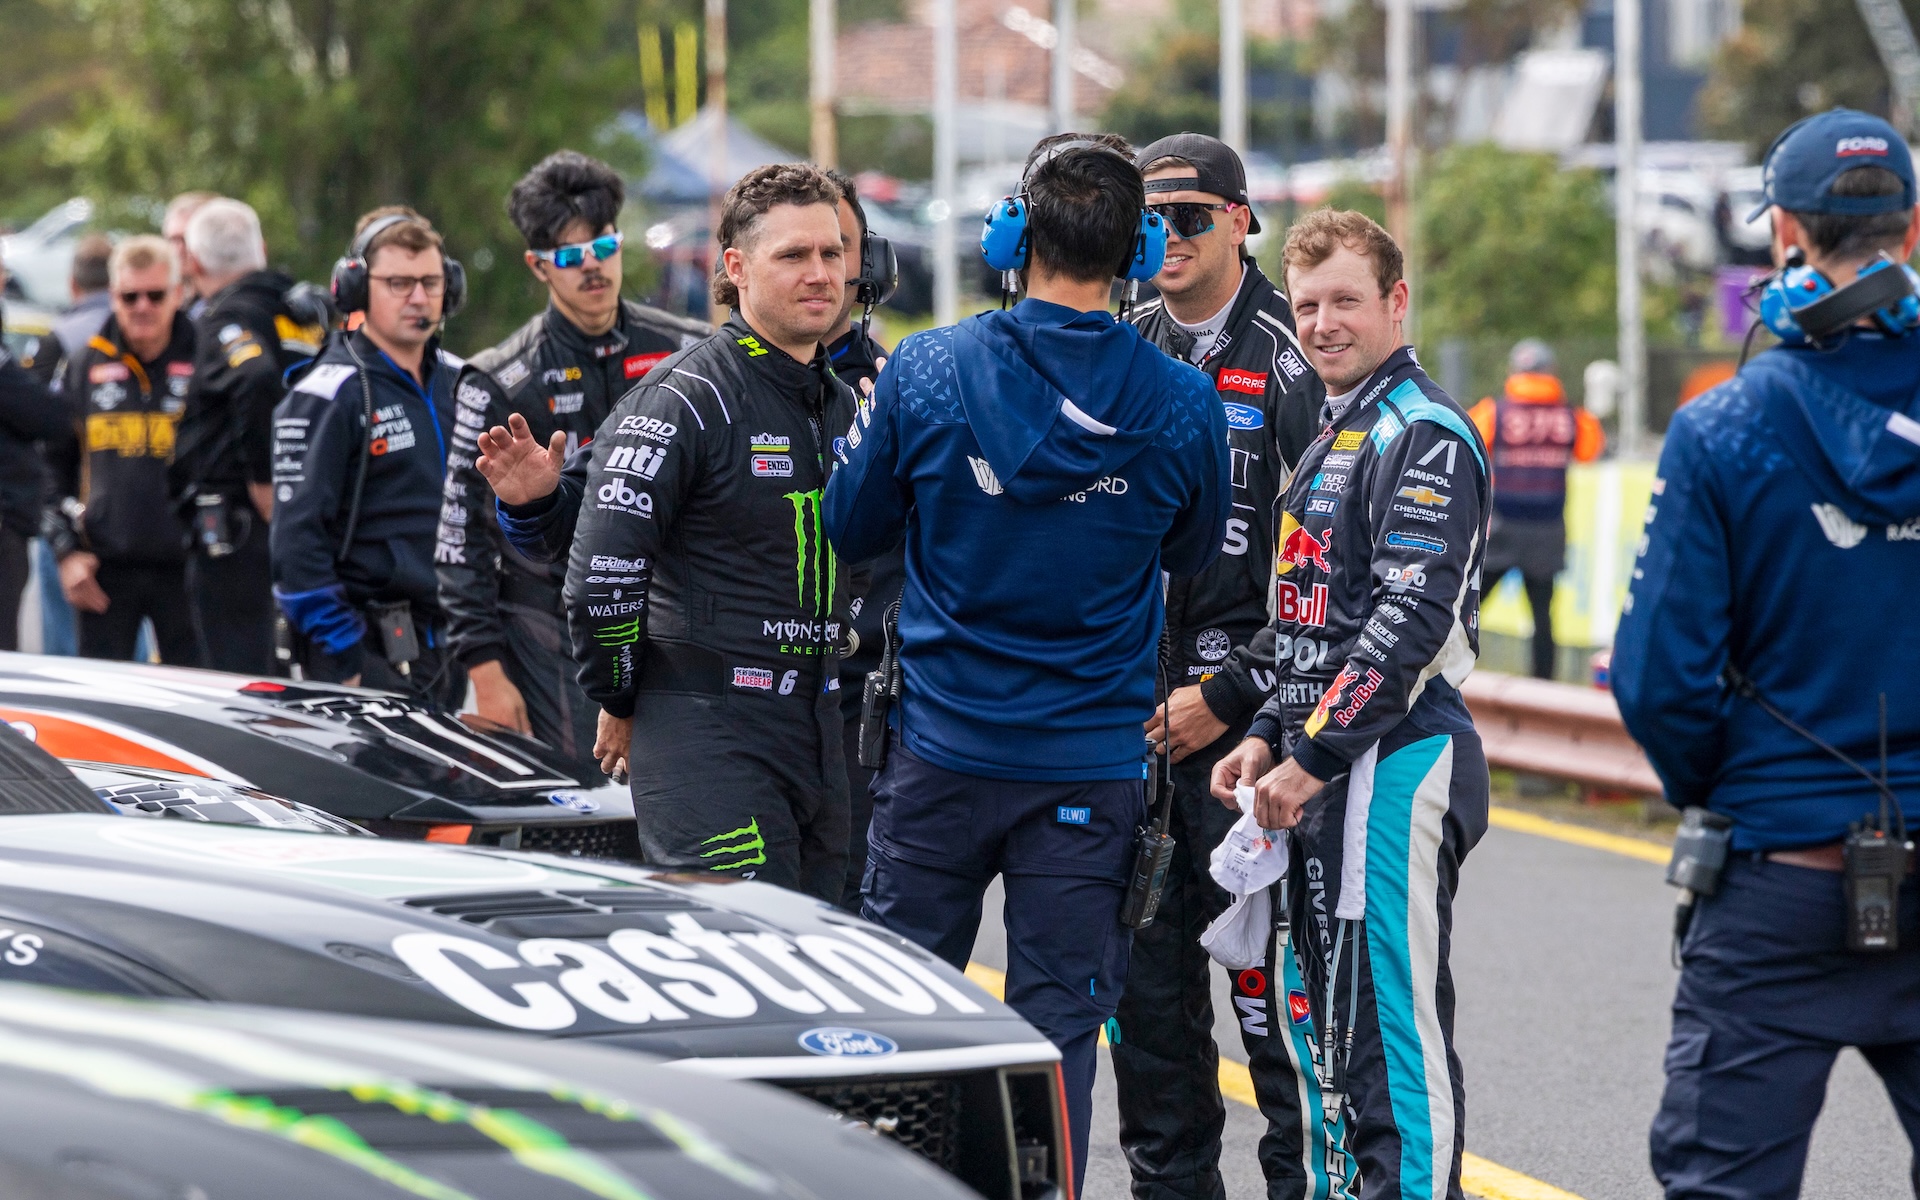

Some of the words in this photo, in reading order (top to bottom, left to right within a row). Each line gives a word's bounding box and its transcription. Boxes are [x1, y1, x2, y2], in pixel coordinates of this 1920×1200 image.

[1836, 136, 1888, 153] FORD
[1279, 350, 1303, 377] OMP
[1222, 375, 1266, 389] MORRIS
[1359, 375, 1393, 410] AMPOL
[618, 415, 677, 437] FORD
[1225, 406, 1254, 426] Ford
[615, 428, 671, 446] PERFORMANCE
[605, 445, 667, 478] nti
[768, 461, 790, 471] ENZED
[1319, 482, 1345, 493] LOCK
[1404, 468, 1451, 488] AMPOL
[598, 477, 653, 512] dba
[1306, 499, 1335, 513] JGI
[1393, 504, 1449, 520] CHEVROLET
[1403, 513, 1437, 523] RACING
[1388, 533, 1443, 553] COMPLETE
[590, 558, 633, 568] Forklifts
[1385, 567, 1426, 587] DPO
[588, 599, 644, 617] WATERS
[1277, 580, 1329, 628] Bull
[1200, 630, 1227, 646] CHEMICAL
[1359, 633, 1387, 662] Suttons
[1276, 632, 1341, 672] POL
[736, 668, 772, 678] PERFORMANCE
[1188, 665, 1223, 676] SUPERC
[735, 676, 772, 687] RACEGEAR
[778, 669, 798, 695] 6
[1061, 808, 1085, 822] ELWD
[1305, 856, 1331, 945] GIVES
[391, 912, 985, 1031] Castrol
[816, 1030, 883, 1054] Ford
